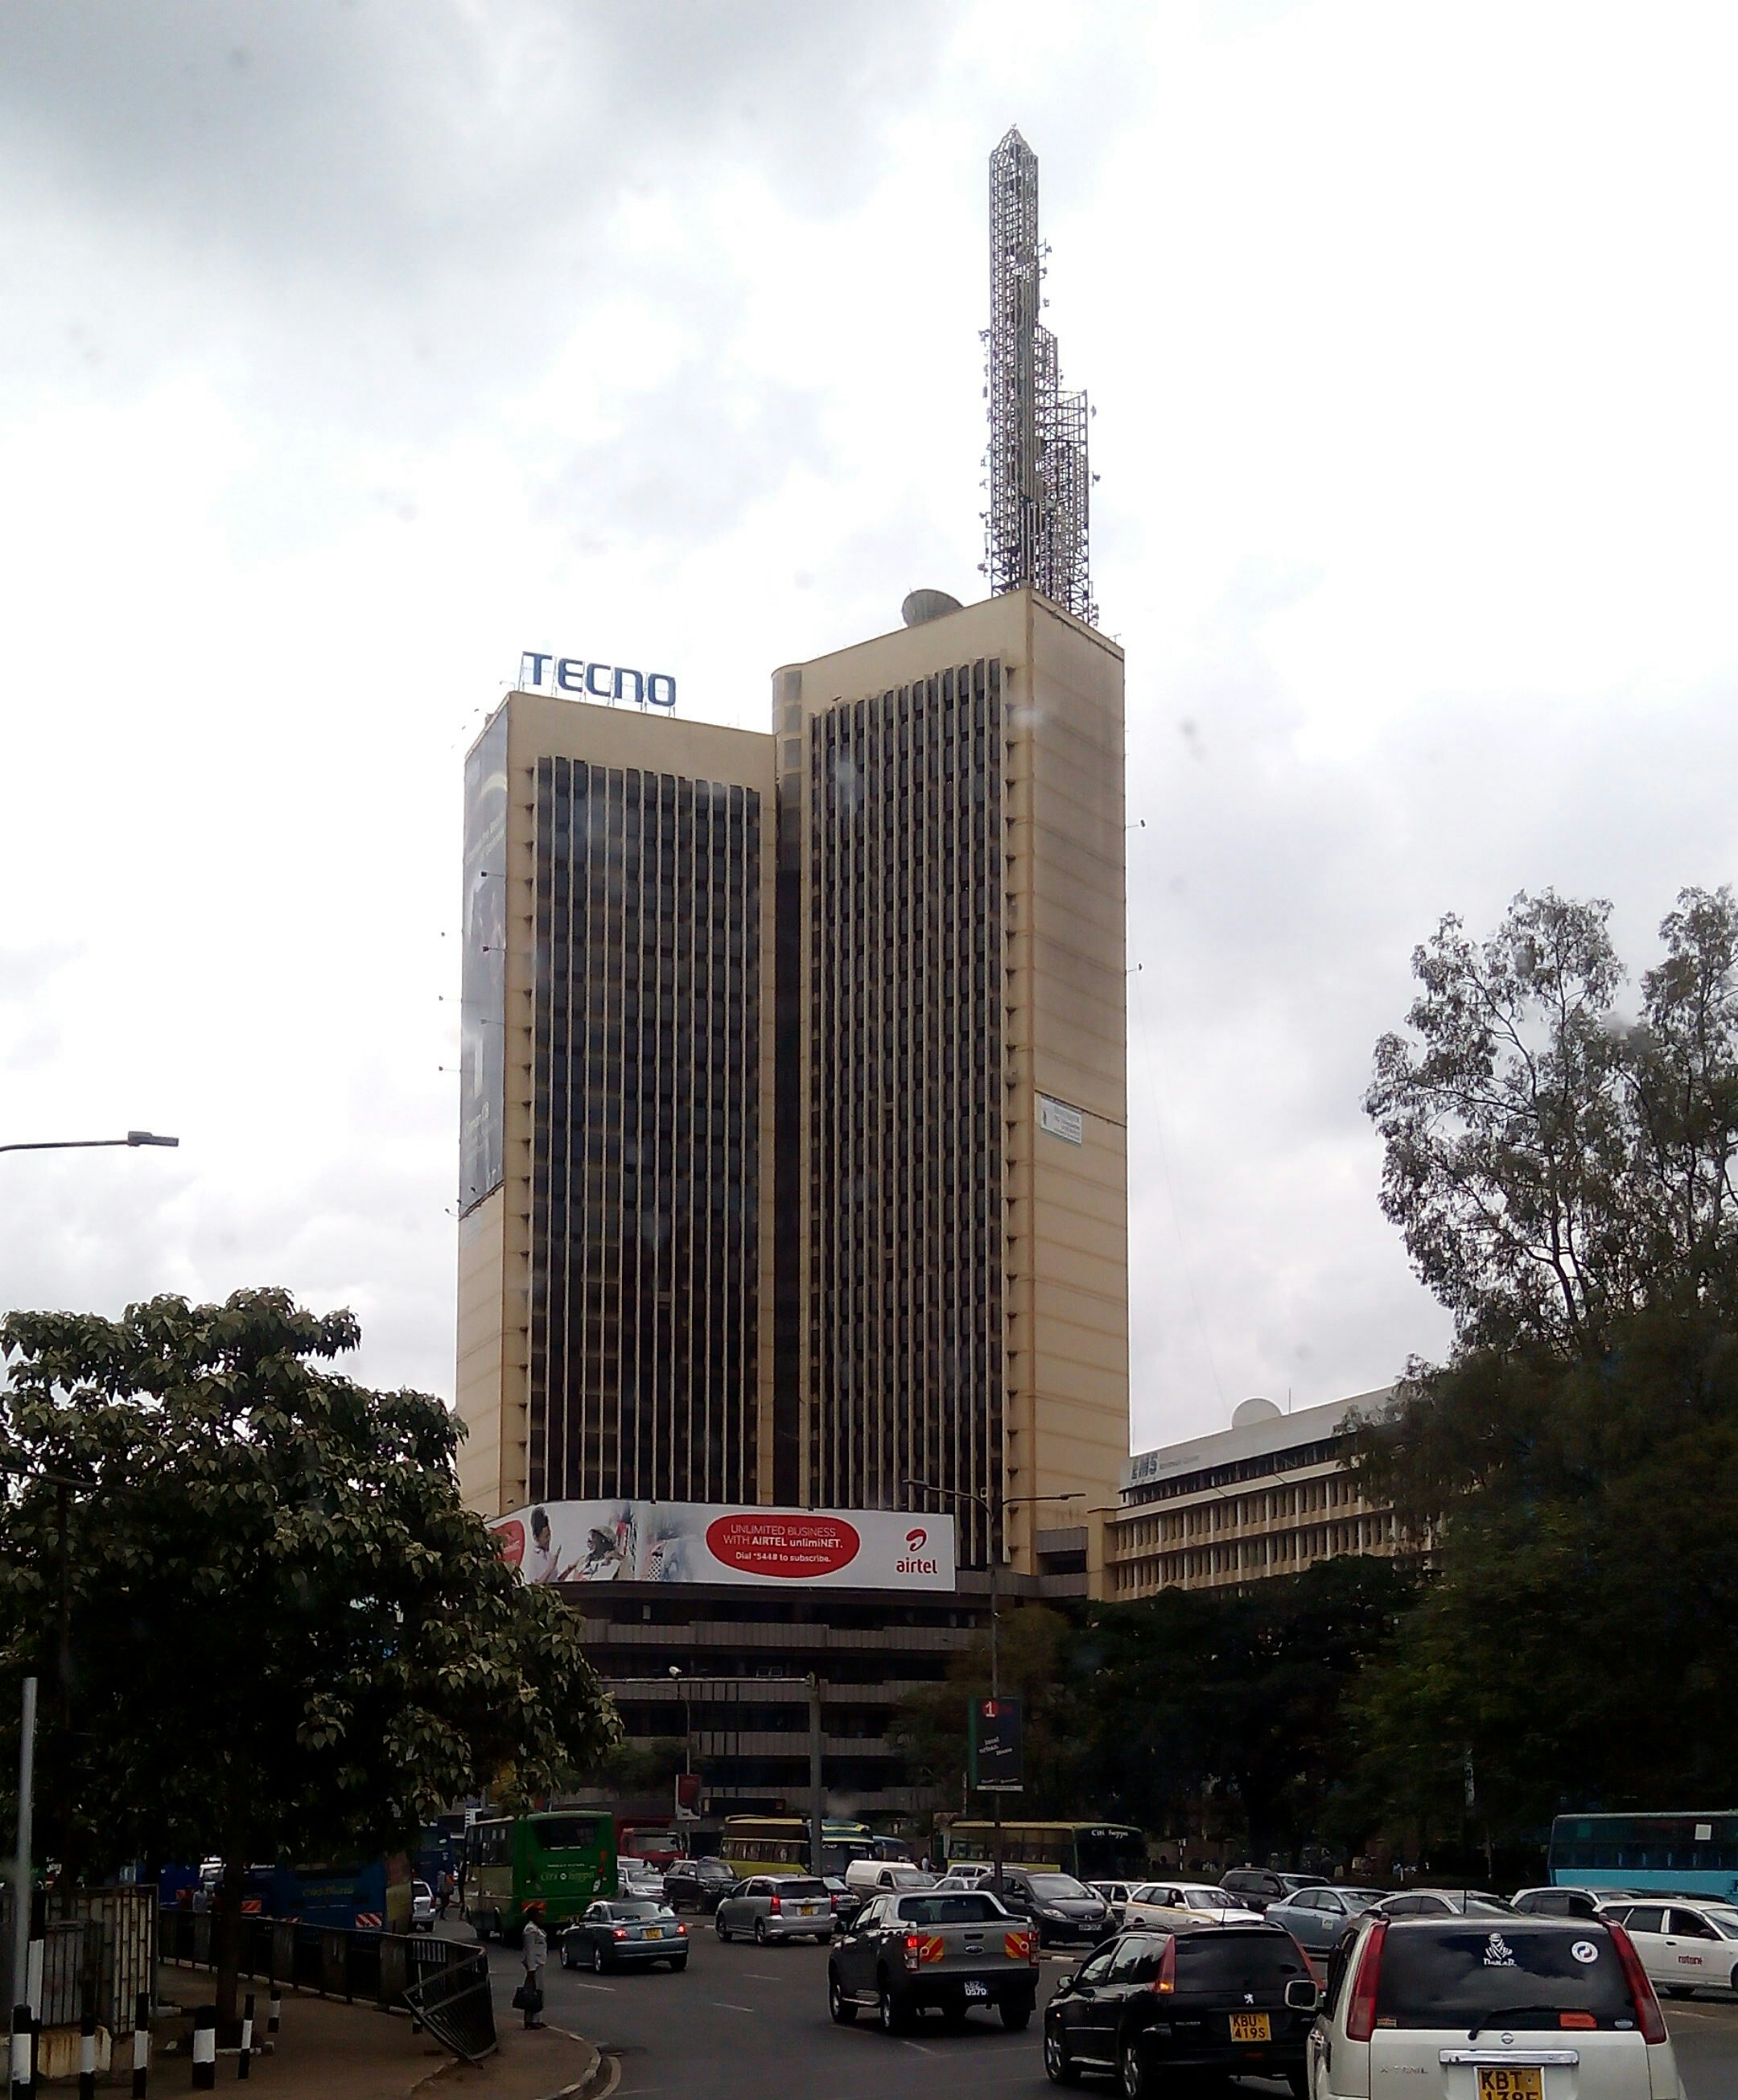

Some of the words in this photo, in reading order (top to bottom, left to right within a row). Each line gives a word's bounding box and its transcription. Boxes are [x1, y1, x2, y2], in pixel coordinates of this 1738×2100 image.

[522, 651, 677, 707] TECNO
[730, 1523, 785, 1535] UNLIMITED
[787, 1526, 836, 1538] BUSINESS
[723, 1534, 750, 1545] WITH
[752, 1536, 788, 1547] AIRTEL
[789, 1538, 843, 1549] unlimiNET.
[735, 1550, 752, 1560] Dial
[779, 1553, 789, 1562] to
[789, 1554, 831, 1563] subscribe.
[896, 1557, 938, 1575] airtel
[1233, 2014, 1257, 2027] KBU
[1234, 2027, 1266, 2039] 419S
[1480, 2070, 1522, 2090] KBT
